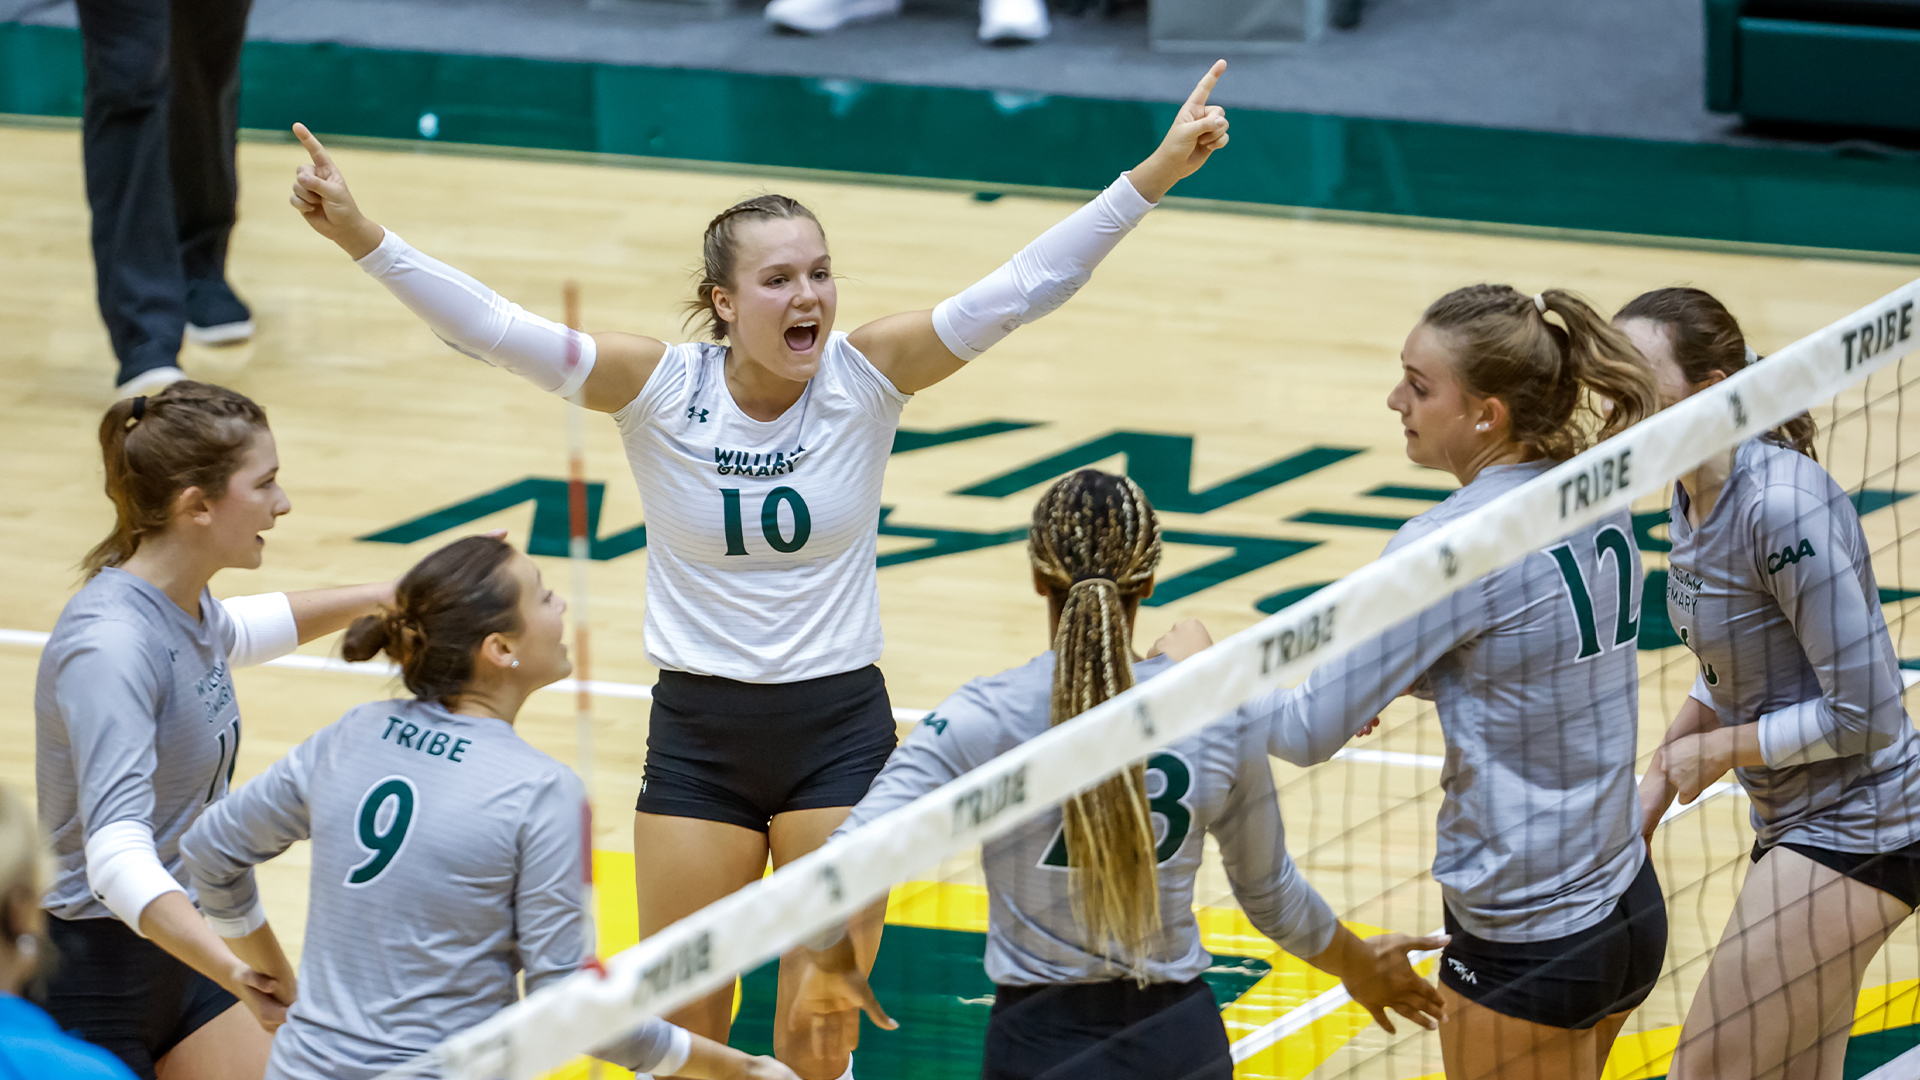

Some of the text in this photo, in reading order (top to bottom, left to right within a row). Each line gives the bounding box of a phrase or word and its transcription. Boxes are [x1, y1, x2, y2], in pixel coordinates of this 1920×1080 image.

[1841, 300, 1914, 372] TRIBE
[1558, 448, 1632, 518] TRIBE
[718, 486, 812, 556] 10
[1767, 538, 1816, 575] CAA
[1541, 523, 1641, 663] 12
[1259, 606, 1337, 675] TRIBE
[381, 715, 473, 763] TRIBE
[343, 775, 420, 888] 9
[1035, 750, 1195, 870] 3
